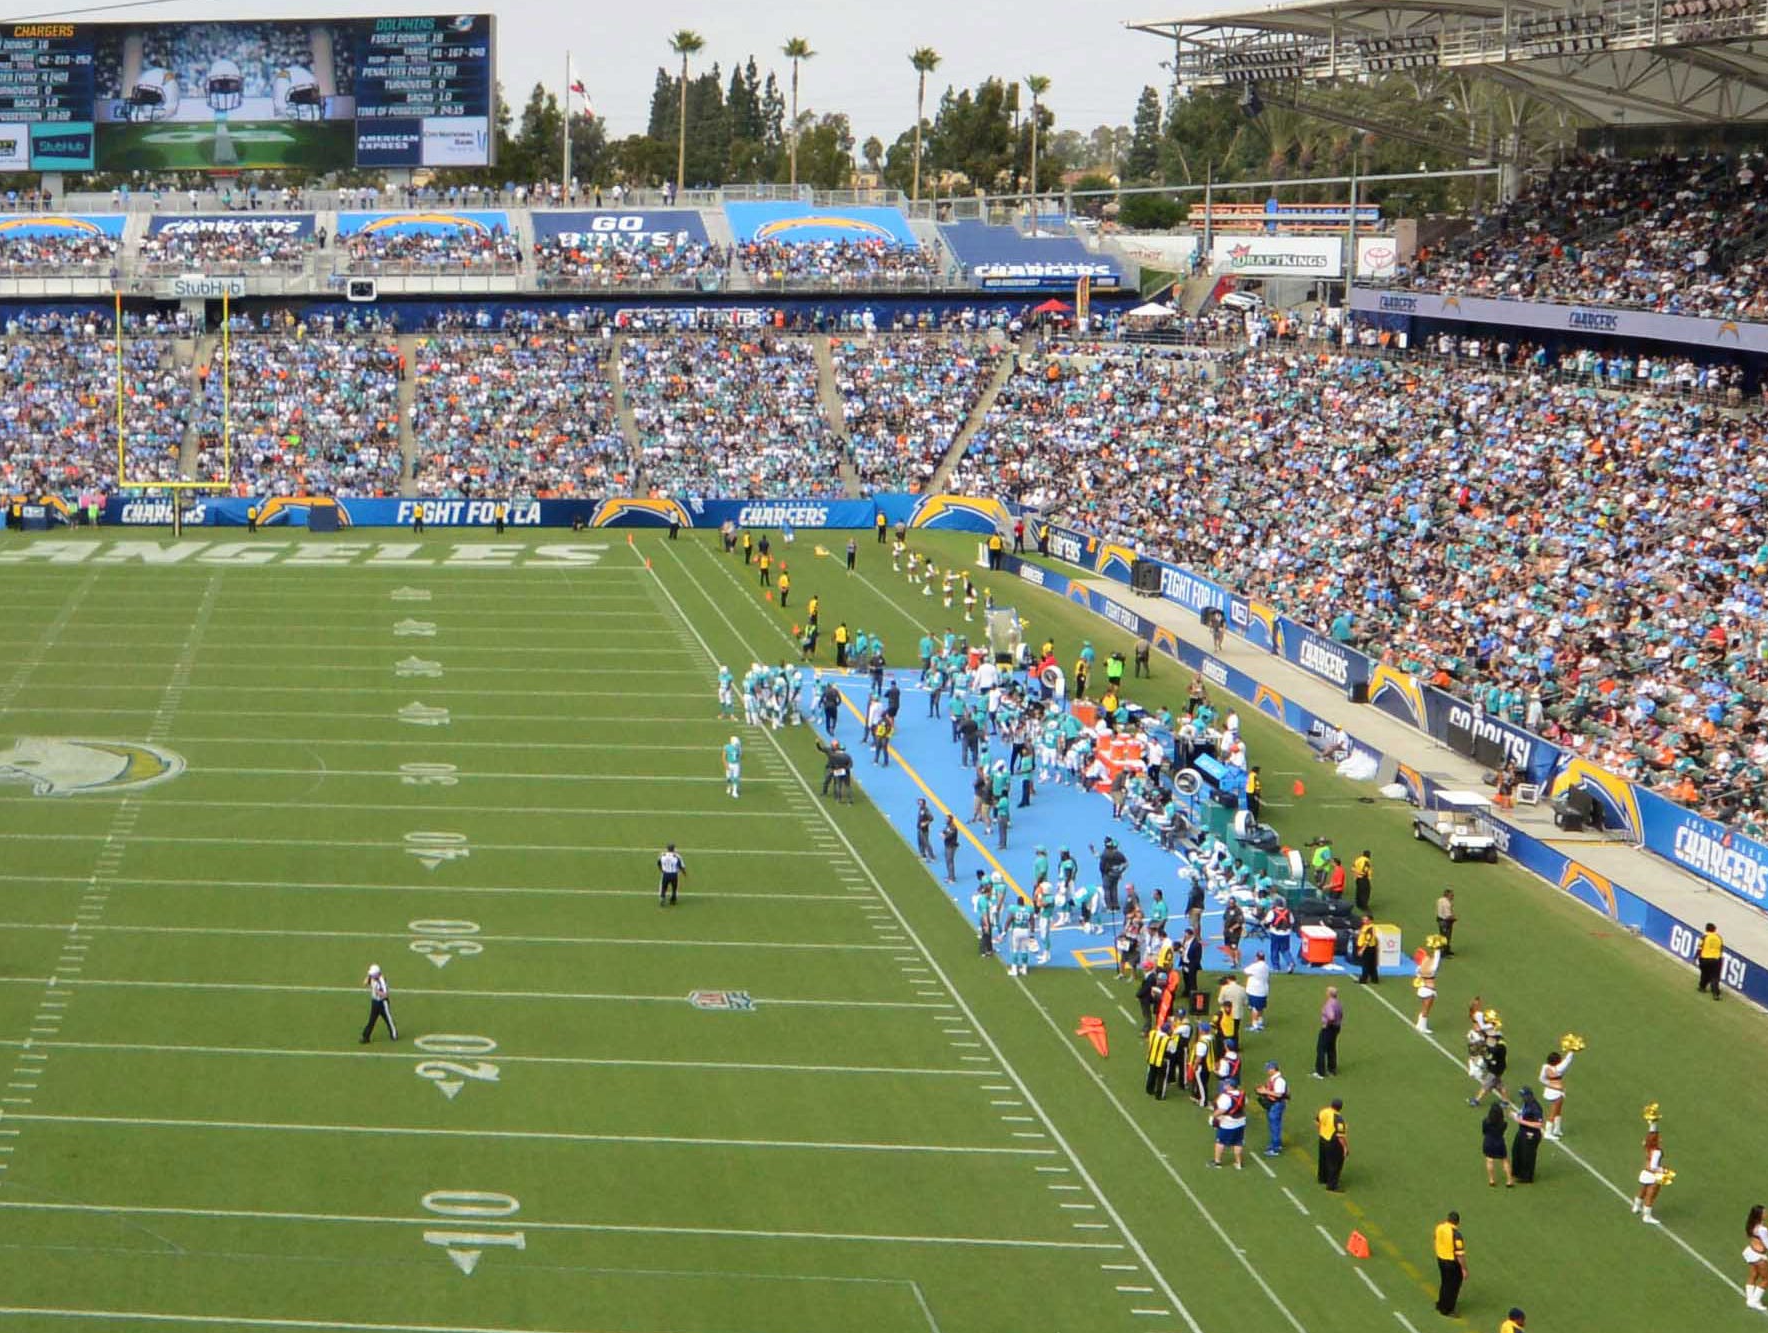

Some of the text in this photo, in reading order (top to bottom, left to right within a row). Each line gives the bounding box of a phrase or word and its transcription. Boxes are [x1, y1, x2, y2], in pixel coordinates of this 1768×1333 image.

[14, 25, 75, 37] CHARGERS
[376, 18, 435, 30] DOLPHINS
[359, 135, 419, 143] AMERICAN
[591, 217, 644, 231] GO
[175, 280, 240, 296] StubHub
[739, 506, 828, 526] CHARGERS
[1161, 568, 1210, 610] FIGHT FOR
[1300, 640, 1349, 686] CHARGERS
[402, 830, 469, 862] 40
[407, 918, 481, 956] 30
[413, 1033, 501, 1083] 20
[421, 1190, 526, 1251] 10
